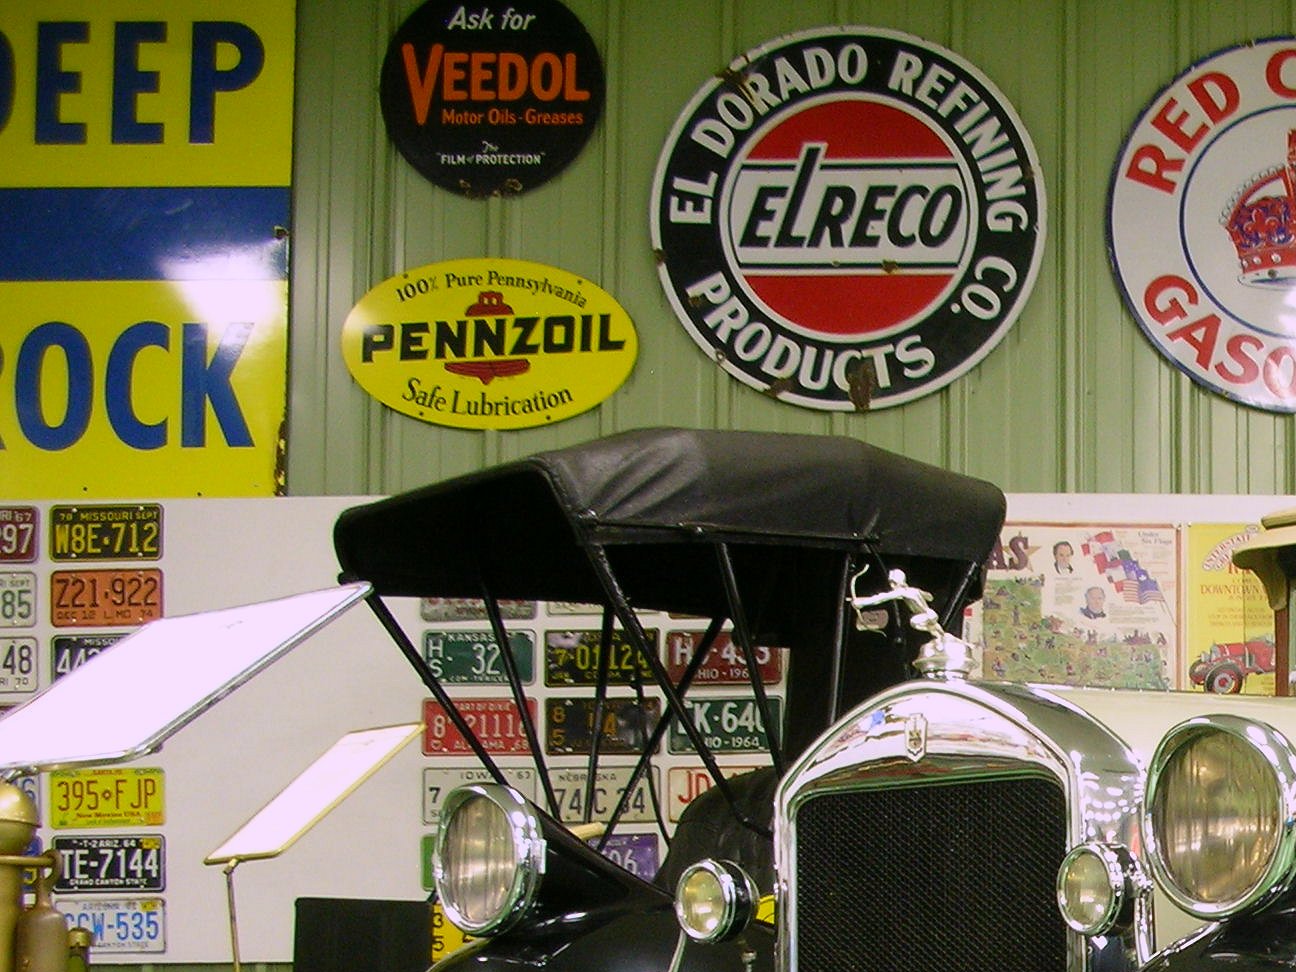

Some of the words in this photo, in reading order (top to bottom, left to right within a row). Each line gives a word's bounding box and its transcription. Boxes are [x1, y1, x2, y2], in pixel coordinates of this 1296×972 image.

[448, 6, 494, 30] Ask
[501, 7, 536, 30] for
[0, 20, 266, 146] EEP
[401, 42, 592, 126] VEEDOL
[691, 43, 868, 159] DORADO
[441, 108, 484, 125] Motor
[888, 50, 1030, 233] REFINING
[1125, 71, 1241, 195] RED
[668, 170, 719, 225] EL
[738, 141, 964, 250] ELRECO
[445, 272, 484, 289] Pure
[487, 270, 588, 308] Pennsylvania
[950, 255, 1017, 321] CO.
[361, 313, 626, 364] PENNZOIL
[685, 271, 936, 392] PRODUCTS
[0, 321, 256, 452] OCK
[401, 377, 447, 412] Safe
[451, 387, 574, 417] Lubrication
[80, 512, 133, 522] MISSOURI
[62, 848, 159, 880] TE-7144
